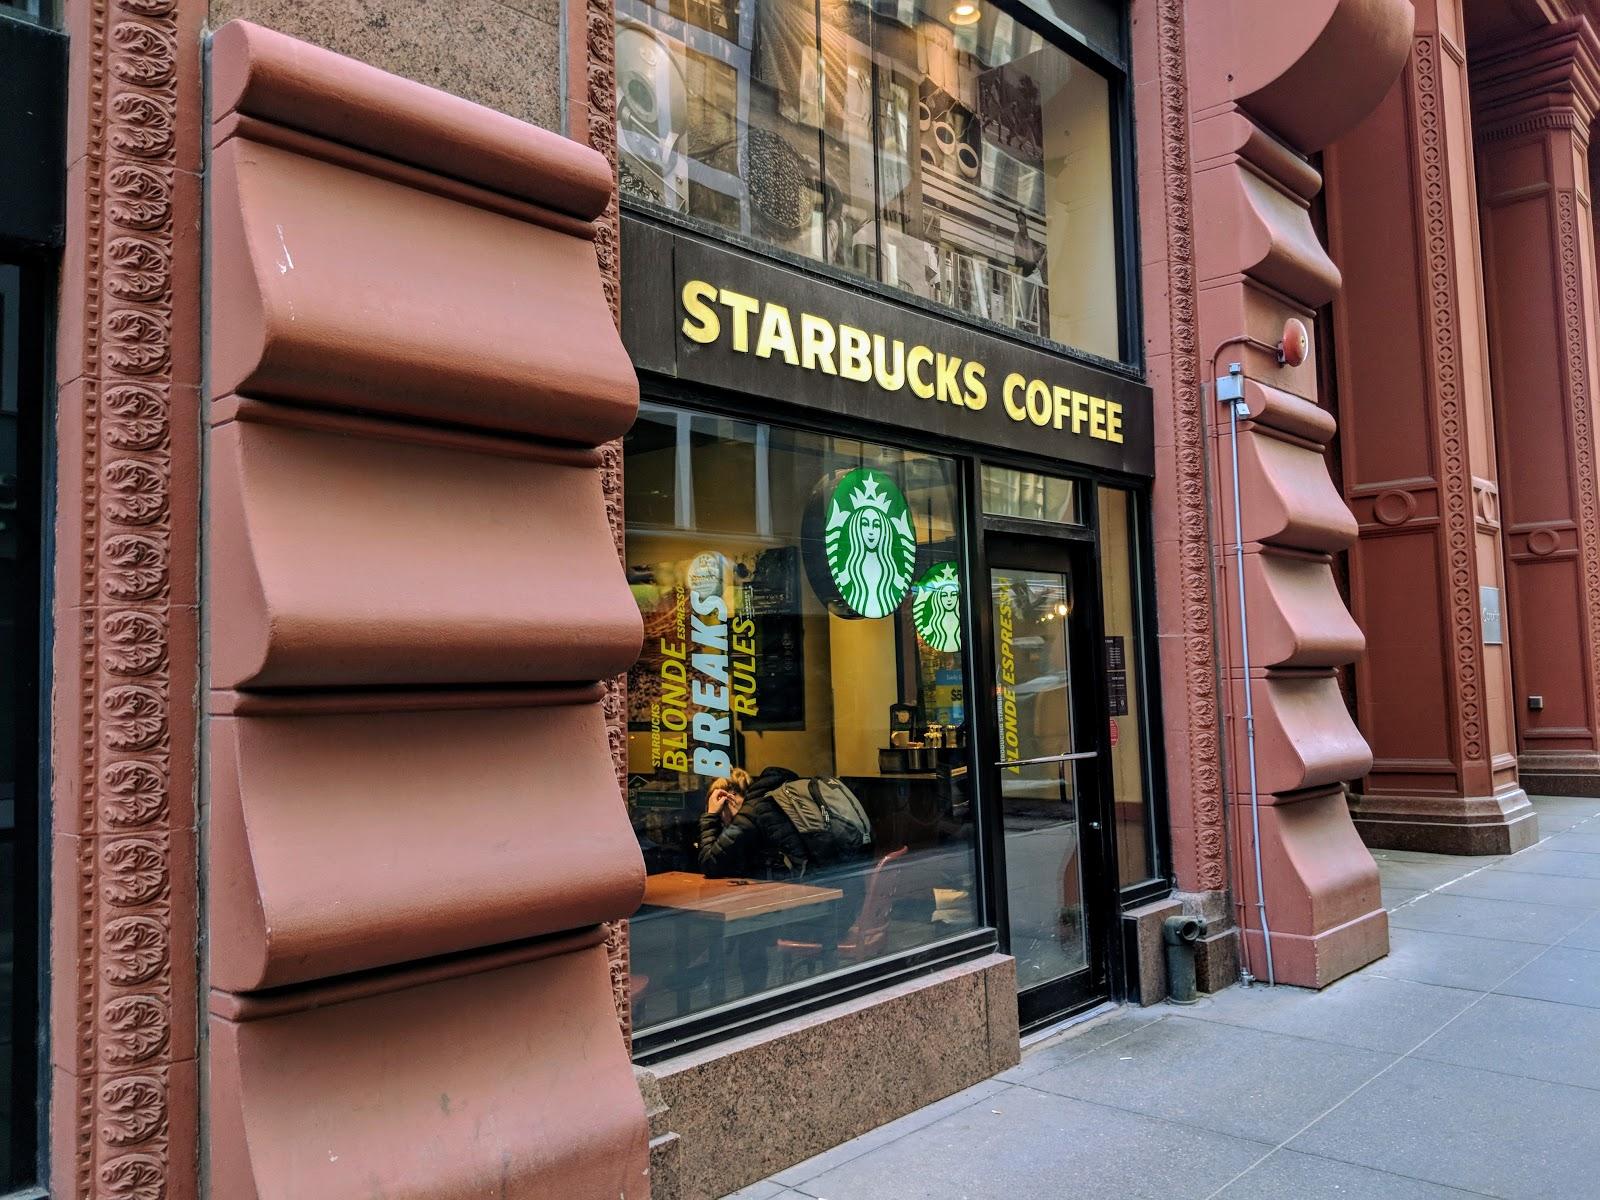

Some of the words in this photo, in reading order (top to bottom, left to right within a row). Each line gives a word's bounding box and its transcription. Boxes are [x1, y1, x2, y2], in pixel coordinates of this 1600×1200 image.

[681, 280, 988, 411] STARBUCKS
[1002, 372, 1124, 444] COFFEE
[652, 703, 661, 768] STARBUCKS
[660, 637, 688, 773] BLONDE
[677, 584, 686, 641] ESPRESSO
[690, 591, 731, 778] BREAKS
[732, 616, 759, 717] RULES
